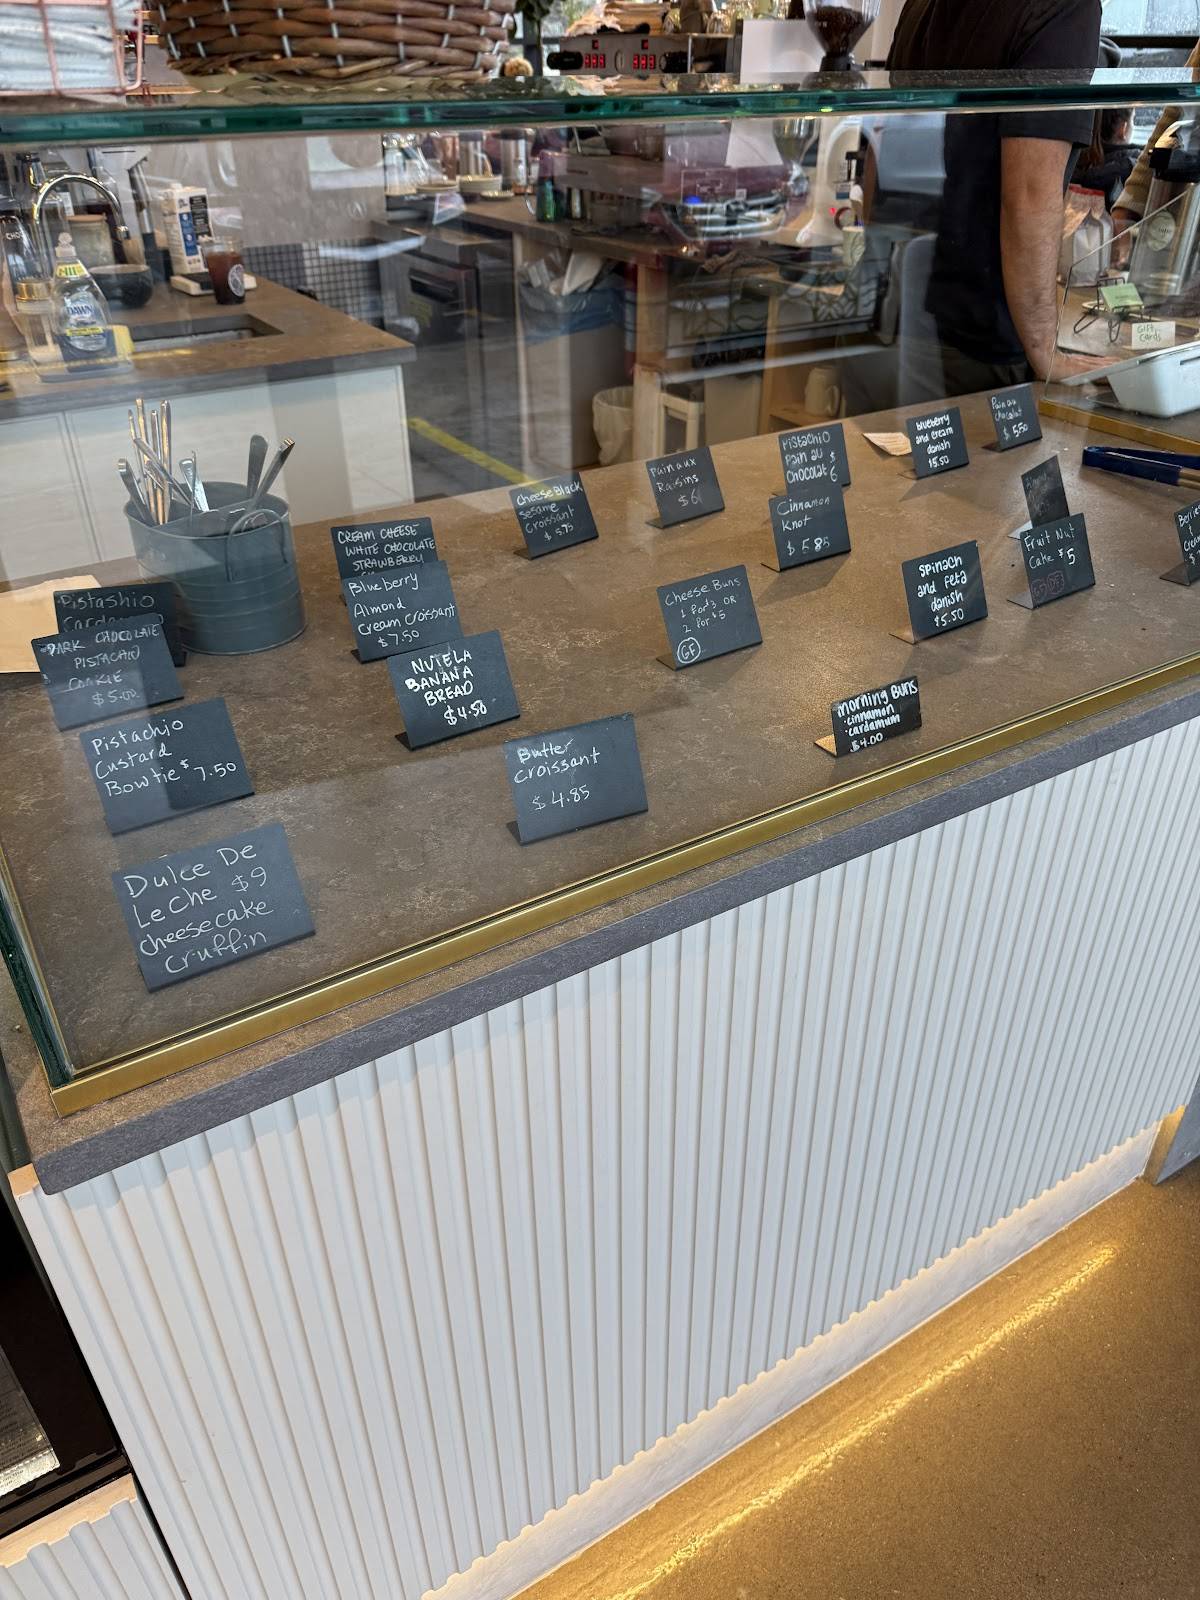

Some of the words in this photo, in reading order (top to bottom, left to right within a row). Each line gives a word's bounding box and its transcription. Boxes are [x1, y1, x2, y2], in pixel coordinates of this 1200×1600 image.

[67, 305, 94, 317] DAWN
[916, 414, 950, 431] blueberry
[916, 433, 929, 445] and
[931, 427, 954, 439] cream
[927, 439, 951, 454] danish
[650, 464, 675, 478] Pain
[676, 458, 697, 469] aux
[516, 488, 554, 506] Cheese
[554, 481, 583, 497] Black
[656, 474, 699, 493] Raisins
[777, 496, 831, 516] Cinnamon
[338, 530, 375, 545] CREAM
[380, 523, 420, 540] CHEESE
[1024, 530, 1051, 552] Fruit
[1055, 522, 1076, 540] Nut
[346, 544, 380, 558] WHITE
[384, 537, 436, 555] CHOCOLATE
[352, 553, 425, 572] STRAWBERRY
[1028, 551, 1055, 569] Cake
[665, 584, 711, 606] Cheese
[712, 578, 741, 591] Buns
[917, 580, 937, 598] and
[944, 570, 967, 589] feta
[354, 597, 407, 619] Almond
[931, 589, 964, 612] danish
[682, 625, 692, 633] 2
[696, 617, 710, 629] for
[46, 639, 86, 657] DARK
[95, 623, 160, 644] CHOCOLATE
[74, 645, 140, 669] PISTACHIO
[411, 649, 473, 675] NUTELA
[681, 643, 696, 660] GF
[404, 665, 474, 692] BANANA
[424, 680, 474, 707] BREAD
[890, 680, 918, 700] Buns
[91, 719, 184, 755] Pistachio
[95, 742, 173, 780] Custard
[516, 736, 576, 764] Butter
[123, 862, 211, 898] Dulce
[217, 843, 257, 867] De
